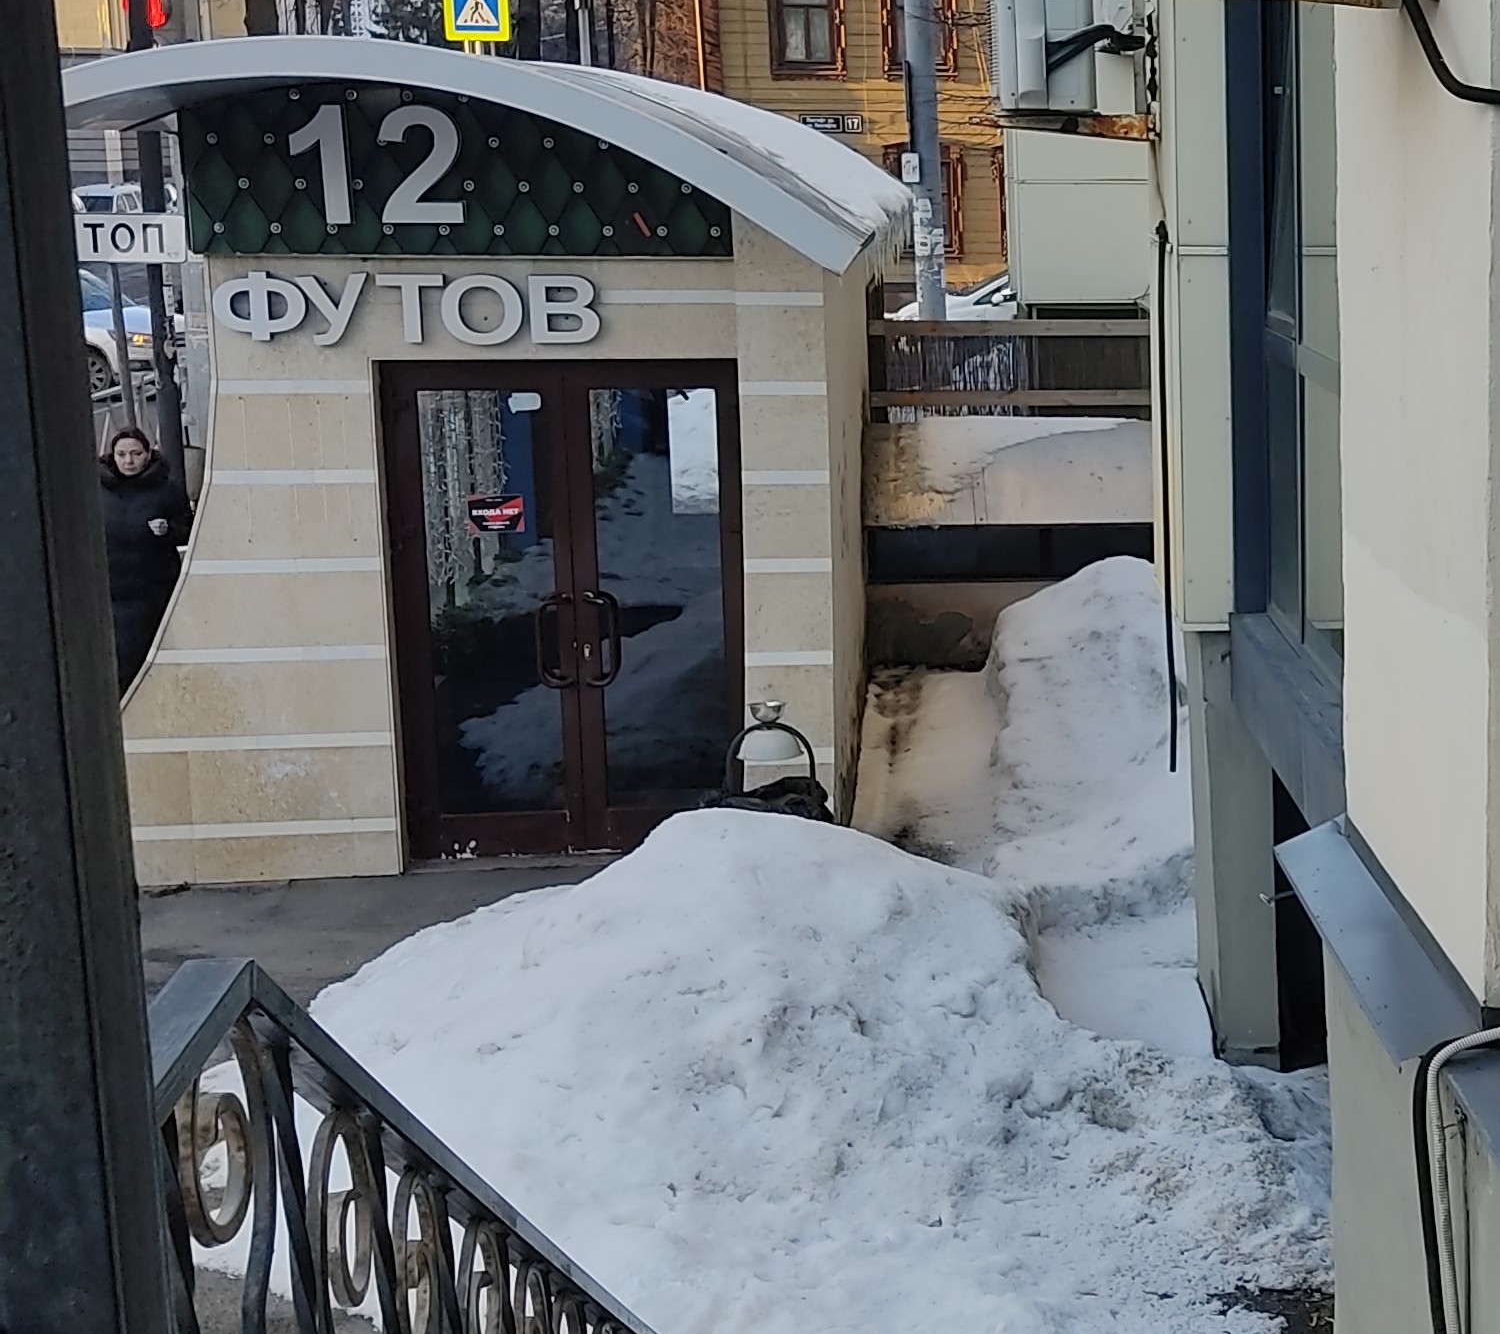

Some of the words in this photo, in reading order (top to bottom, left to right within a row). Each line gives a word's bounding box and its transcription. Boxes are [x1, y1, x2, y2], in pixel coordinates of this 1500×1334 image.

[847, 118, 859, 130] 17
[288, 104, 467, 225] 12
[82, 222, 165, 255] ТОП
[212, 271, 602, 347] ФУТОВ
[471, 508, 502, 517] ВХОДА
